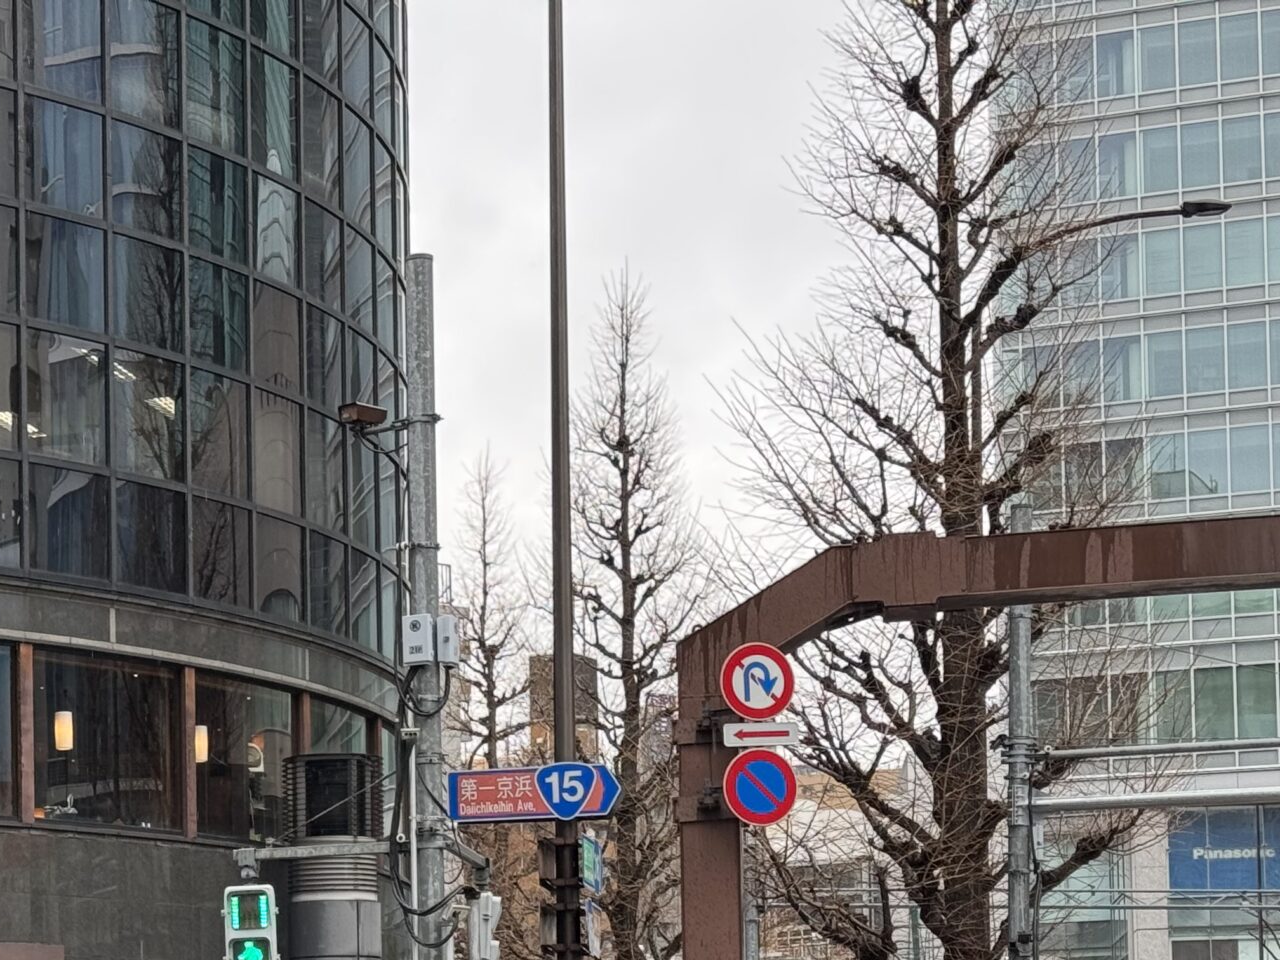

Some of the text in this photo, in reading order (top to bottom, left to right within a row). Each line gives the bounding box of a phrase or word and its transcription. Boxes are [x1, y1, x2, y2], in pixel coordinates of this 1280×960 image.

[460, 775, 533, 802] 第一京浜
[544, 770, 585, 804] 15
[459, 800, 514, 815] Daiichikeihin
